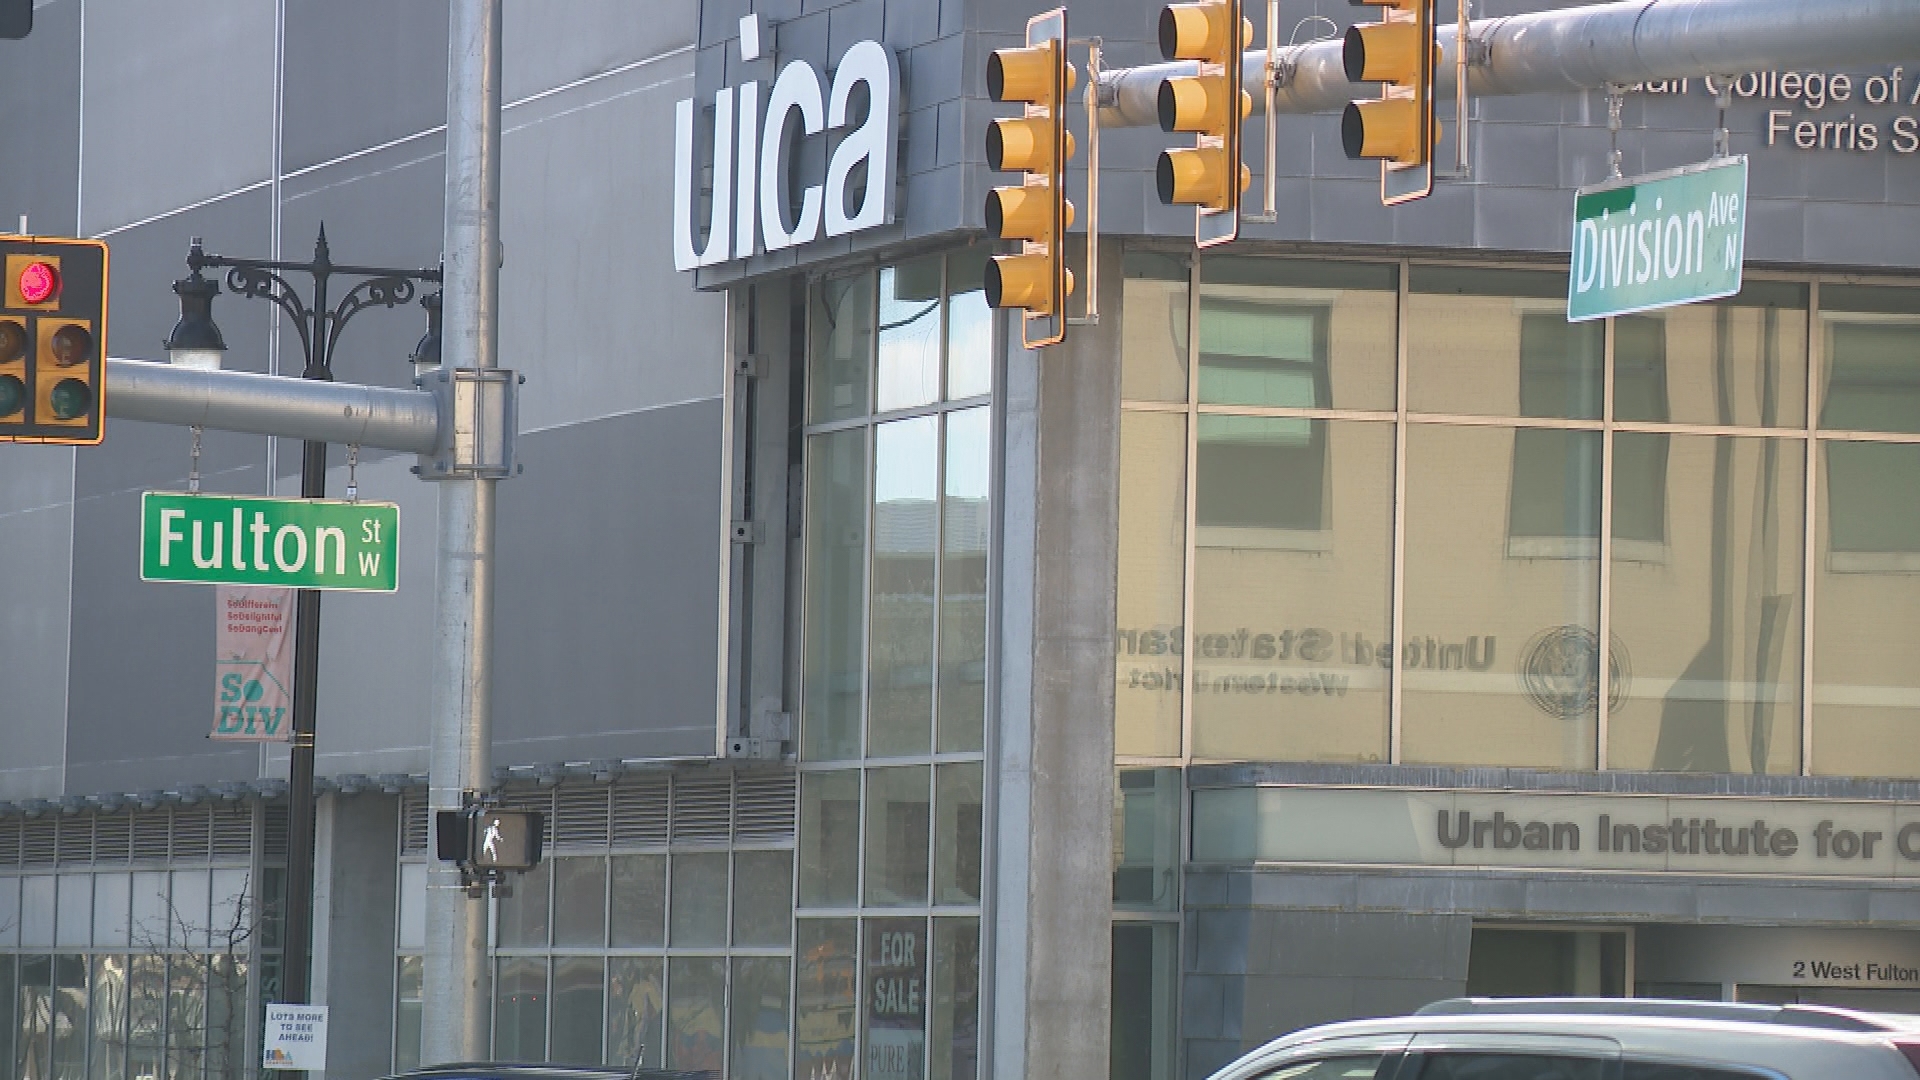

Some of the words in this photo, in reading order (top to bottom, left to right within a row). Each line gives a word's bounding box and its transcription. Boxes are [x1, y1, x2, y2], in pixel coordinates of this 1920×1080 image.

[1864, 66, 1904, 104] of
[673, 13, 895, 272] uica
[1768, 109, 1879, 151] Ferris
[1576, 196, 1704, 293] Division
[1708, 191, 1740, 228] Ave
[1724, 233, 1738, 271] N
[159, 507, 347, 575] Fulton
[361, 518, 382, 543] St
[358, 551, 381, 577] W
[217, 706, 286, 736] DIV
[1437, 809, 1581, 851] Urban
[1599, 813, 1799, 857] Institute
[1813, 820, 1882, 860] for
[880, 931, 916, 967] FOR
[1793, 960, 1806, 979] 2
[1810, 960, 1861, 980] West
[1866, 963, 1920, 982] Fulton
[874, 977, 920, 1013] SALE
[280, 1023, 293, 1031] TO
[295, 1023, 313, 1032] SEE
[297, 1013, 324, 1022] MORE
[870, 1044, 905, 1073] PURE
